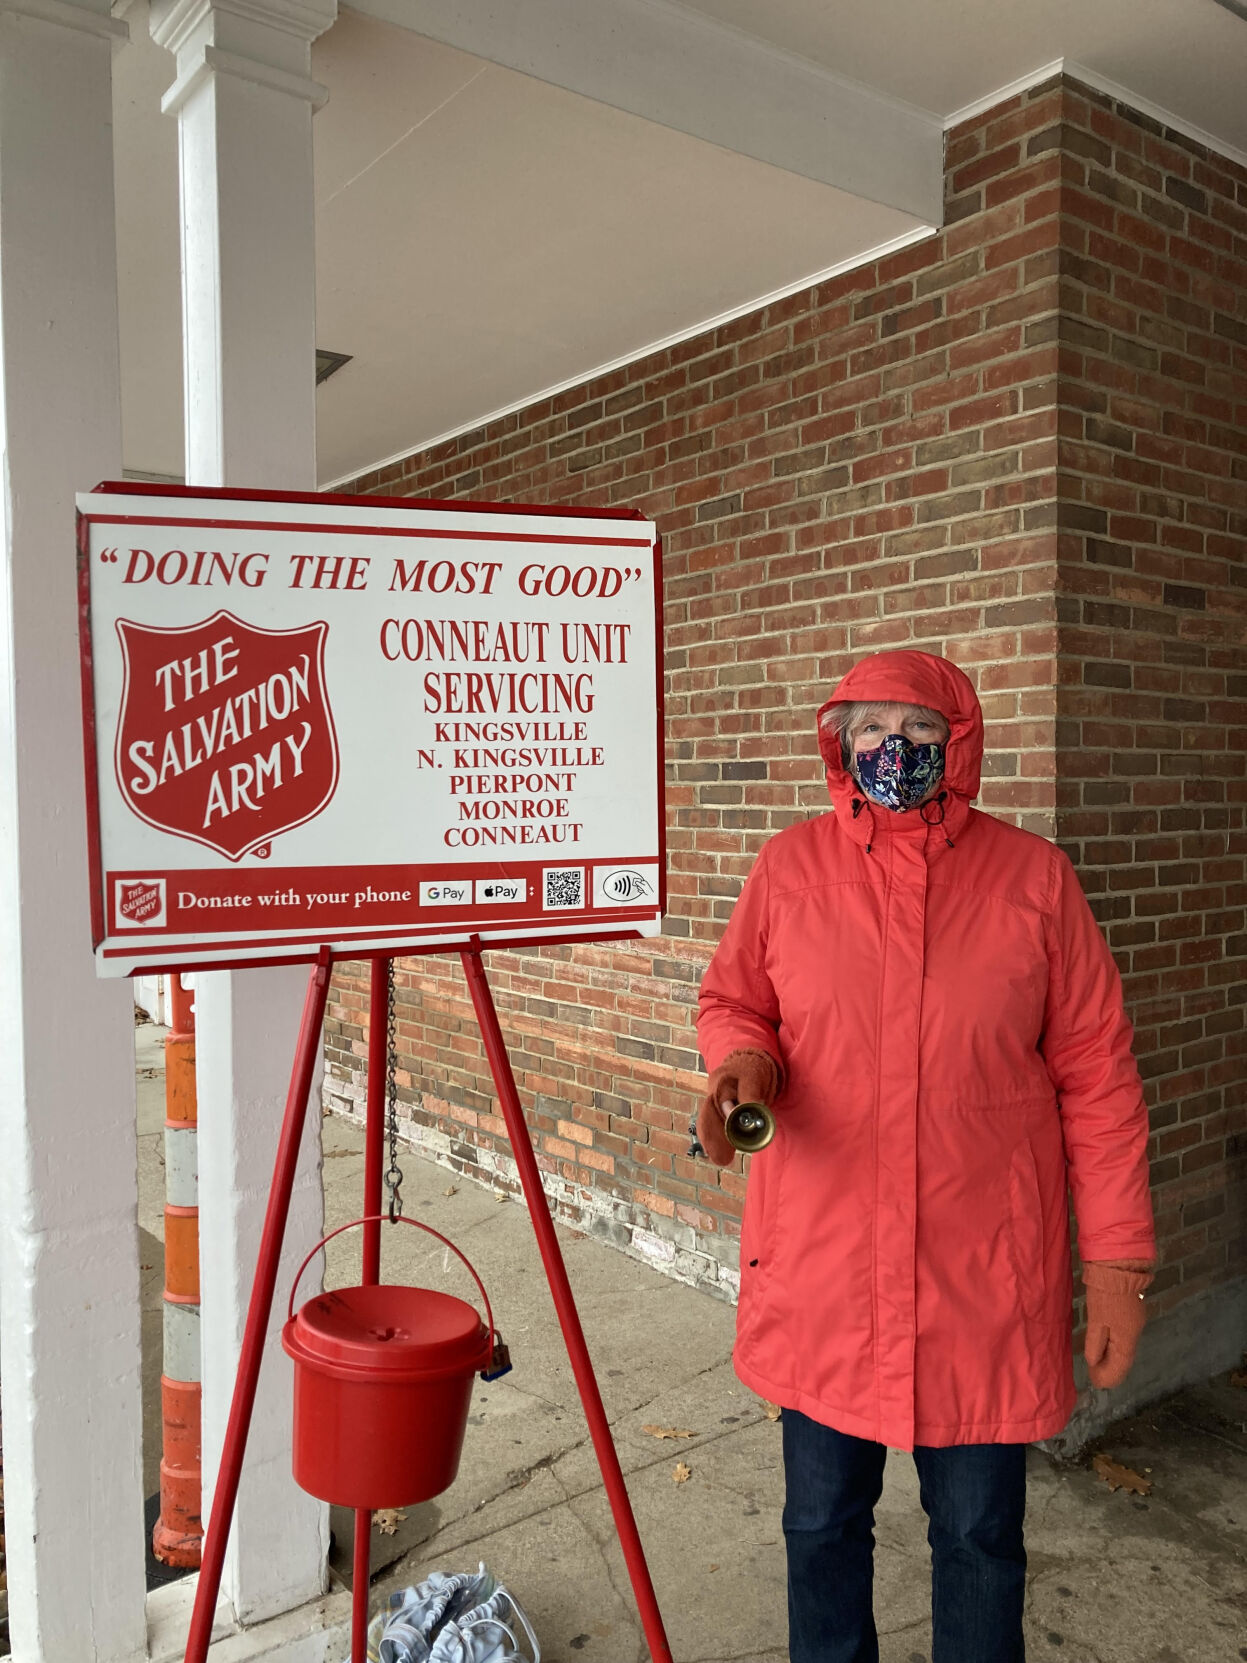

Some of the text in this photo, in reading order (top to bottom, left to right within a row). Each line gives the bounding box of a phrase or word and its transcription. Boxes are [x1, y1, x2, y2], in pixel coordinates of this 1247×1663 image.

[288, 555, 371, 590] THE
[388, 558, 502, 595] MOST
[518, 563, 642, 598] GOOD”
[380, 618, 631, 664] CONNEAUT UNIT
[155, 636, 240, 712] THE
[423, 672, 595, 714] SERVICING
[128, 654, 311, 795] SALVATION
[434, 722, 588, 743] KINGSVILLE
[416, 747, 605, 769] N. KINGSVILLE
[203, 721, 312, 829] ARMY
[449, 773, 577, 795] PIERPONT
[458, 798, 569, 821] MONROE
[444, 823, 583, 847] CONNEAUT
[122, 887, 158, 914] SALVATION
[127, 885, 144, 900] THE
[177, 885, 411, 910] Donate with your phone
[427, 887, 464, 901] G Pay
[495, 885, 518, 899] Pay
[134, 899, 156, 919] ARMY
